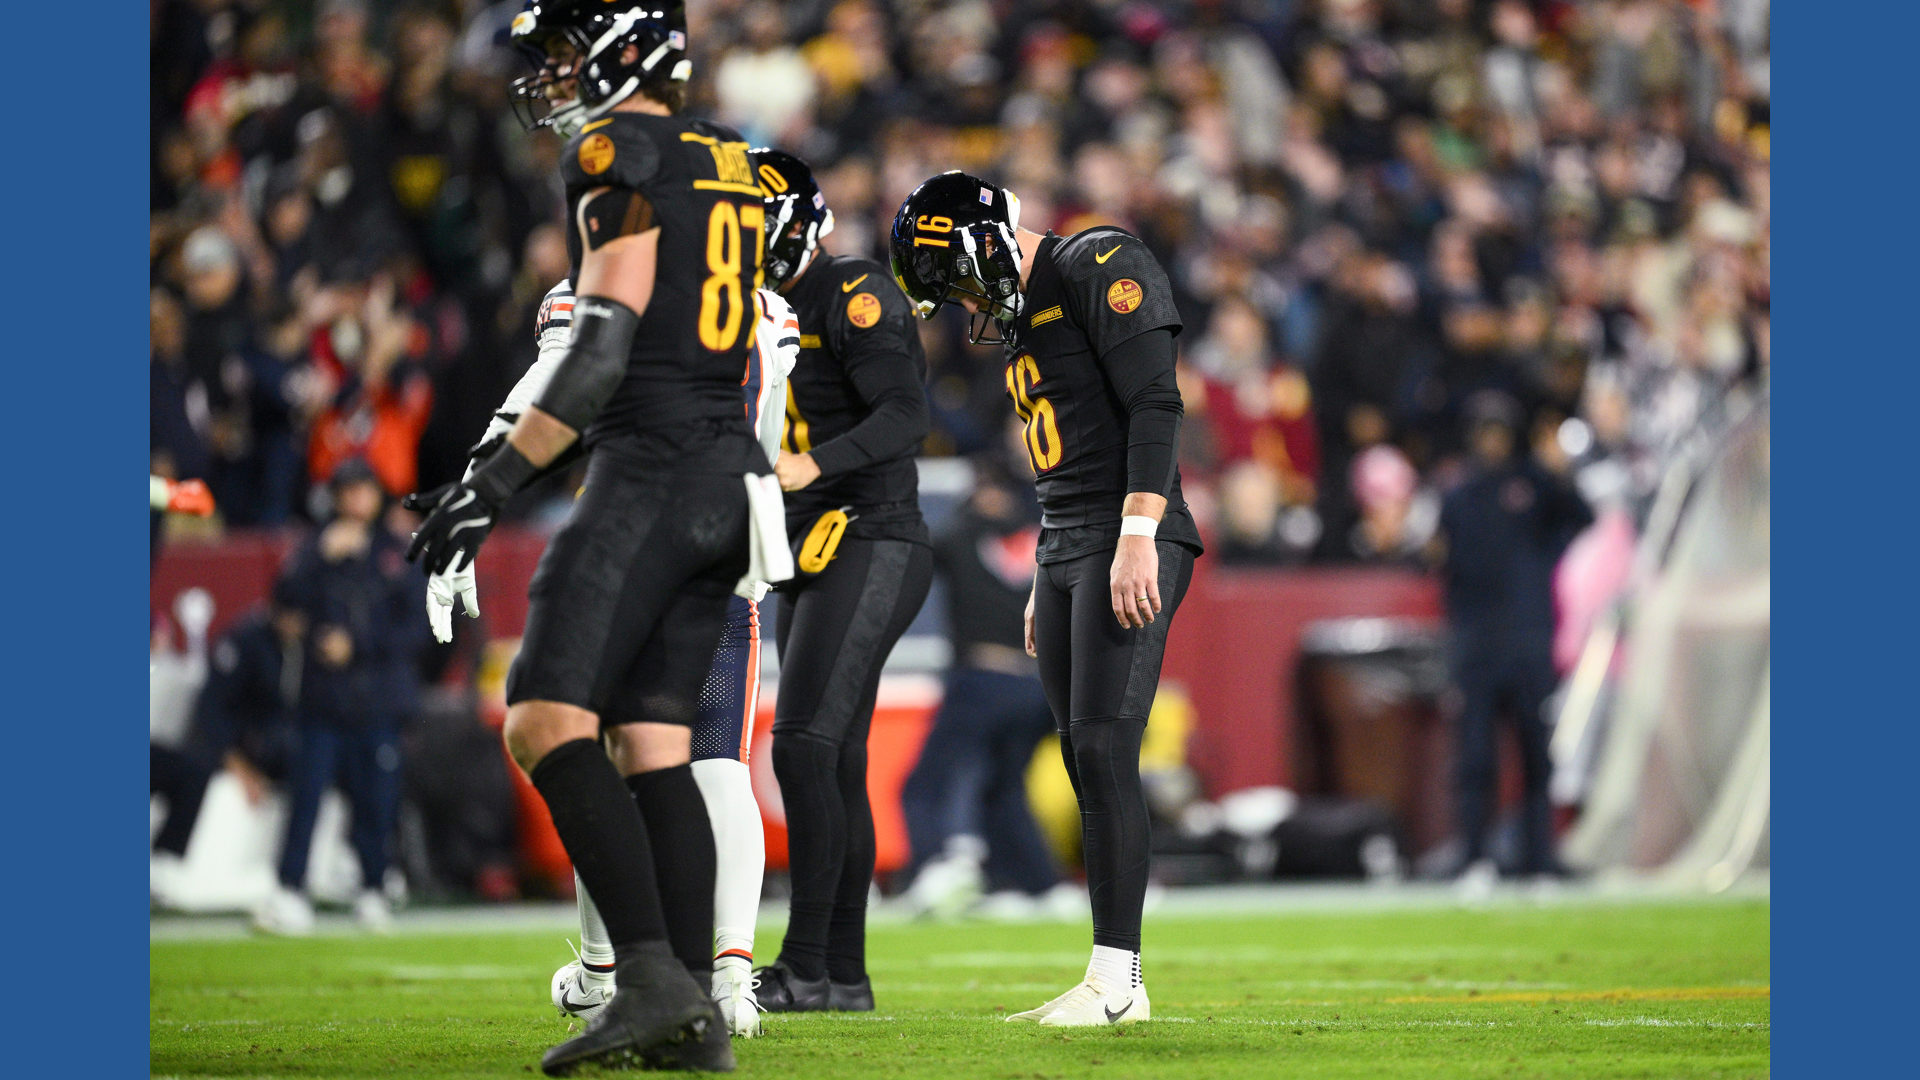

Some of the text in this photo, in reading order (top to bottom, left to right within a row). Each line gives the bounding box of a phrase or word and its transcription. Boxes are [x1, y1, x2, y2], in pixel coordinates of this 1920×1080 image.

[697, 199, 765, 352] 87
[914, 214, 954, 248] 16
[1005, 352, 1064, 473] 16
